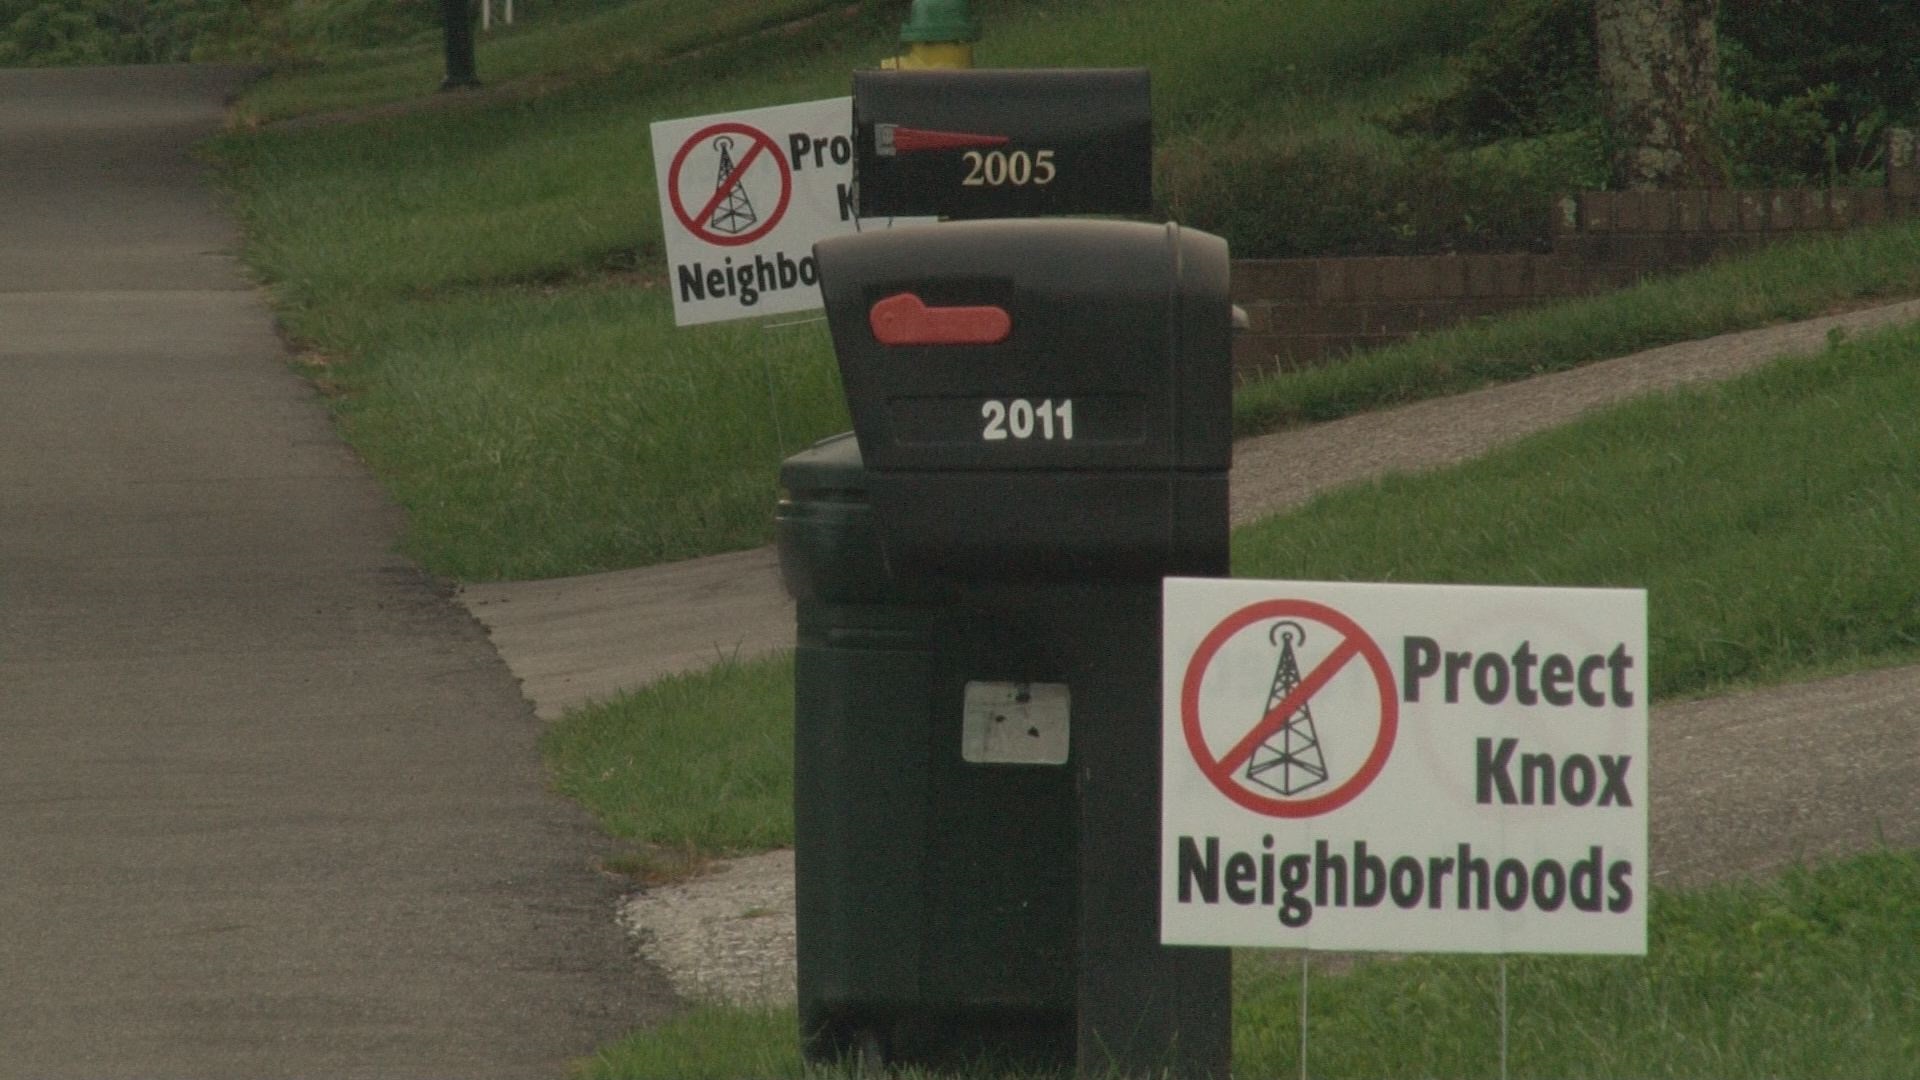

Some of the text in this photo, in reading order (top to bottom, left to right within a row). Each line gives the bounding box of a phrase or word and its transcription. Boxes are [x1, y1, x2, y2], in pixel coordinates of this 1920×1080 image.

[789, 132, 853, 171] Pro
[962, 149, 1056, 186] 2005
[982, 398, 1074, 440] 2011
[1403, 635, 1634, 708] Protect
[1475, 736, 1632, 808] Knox
[1177, 832, 1633, 928] Neighborhoods
